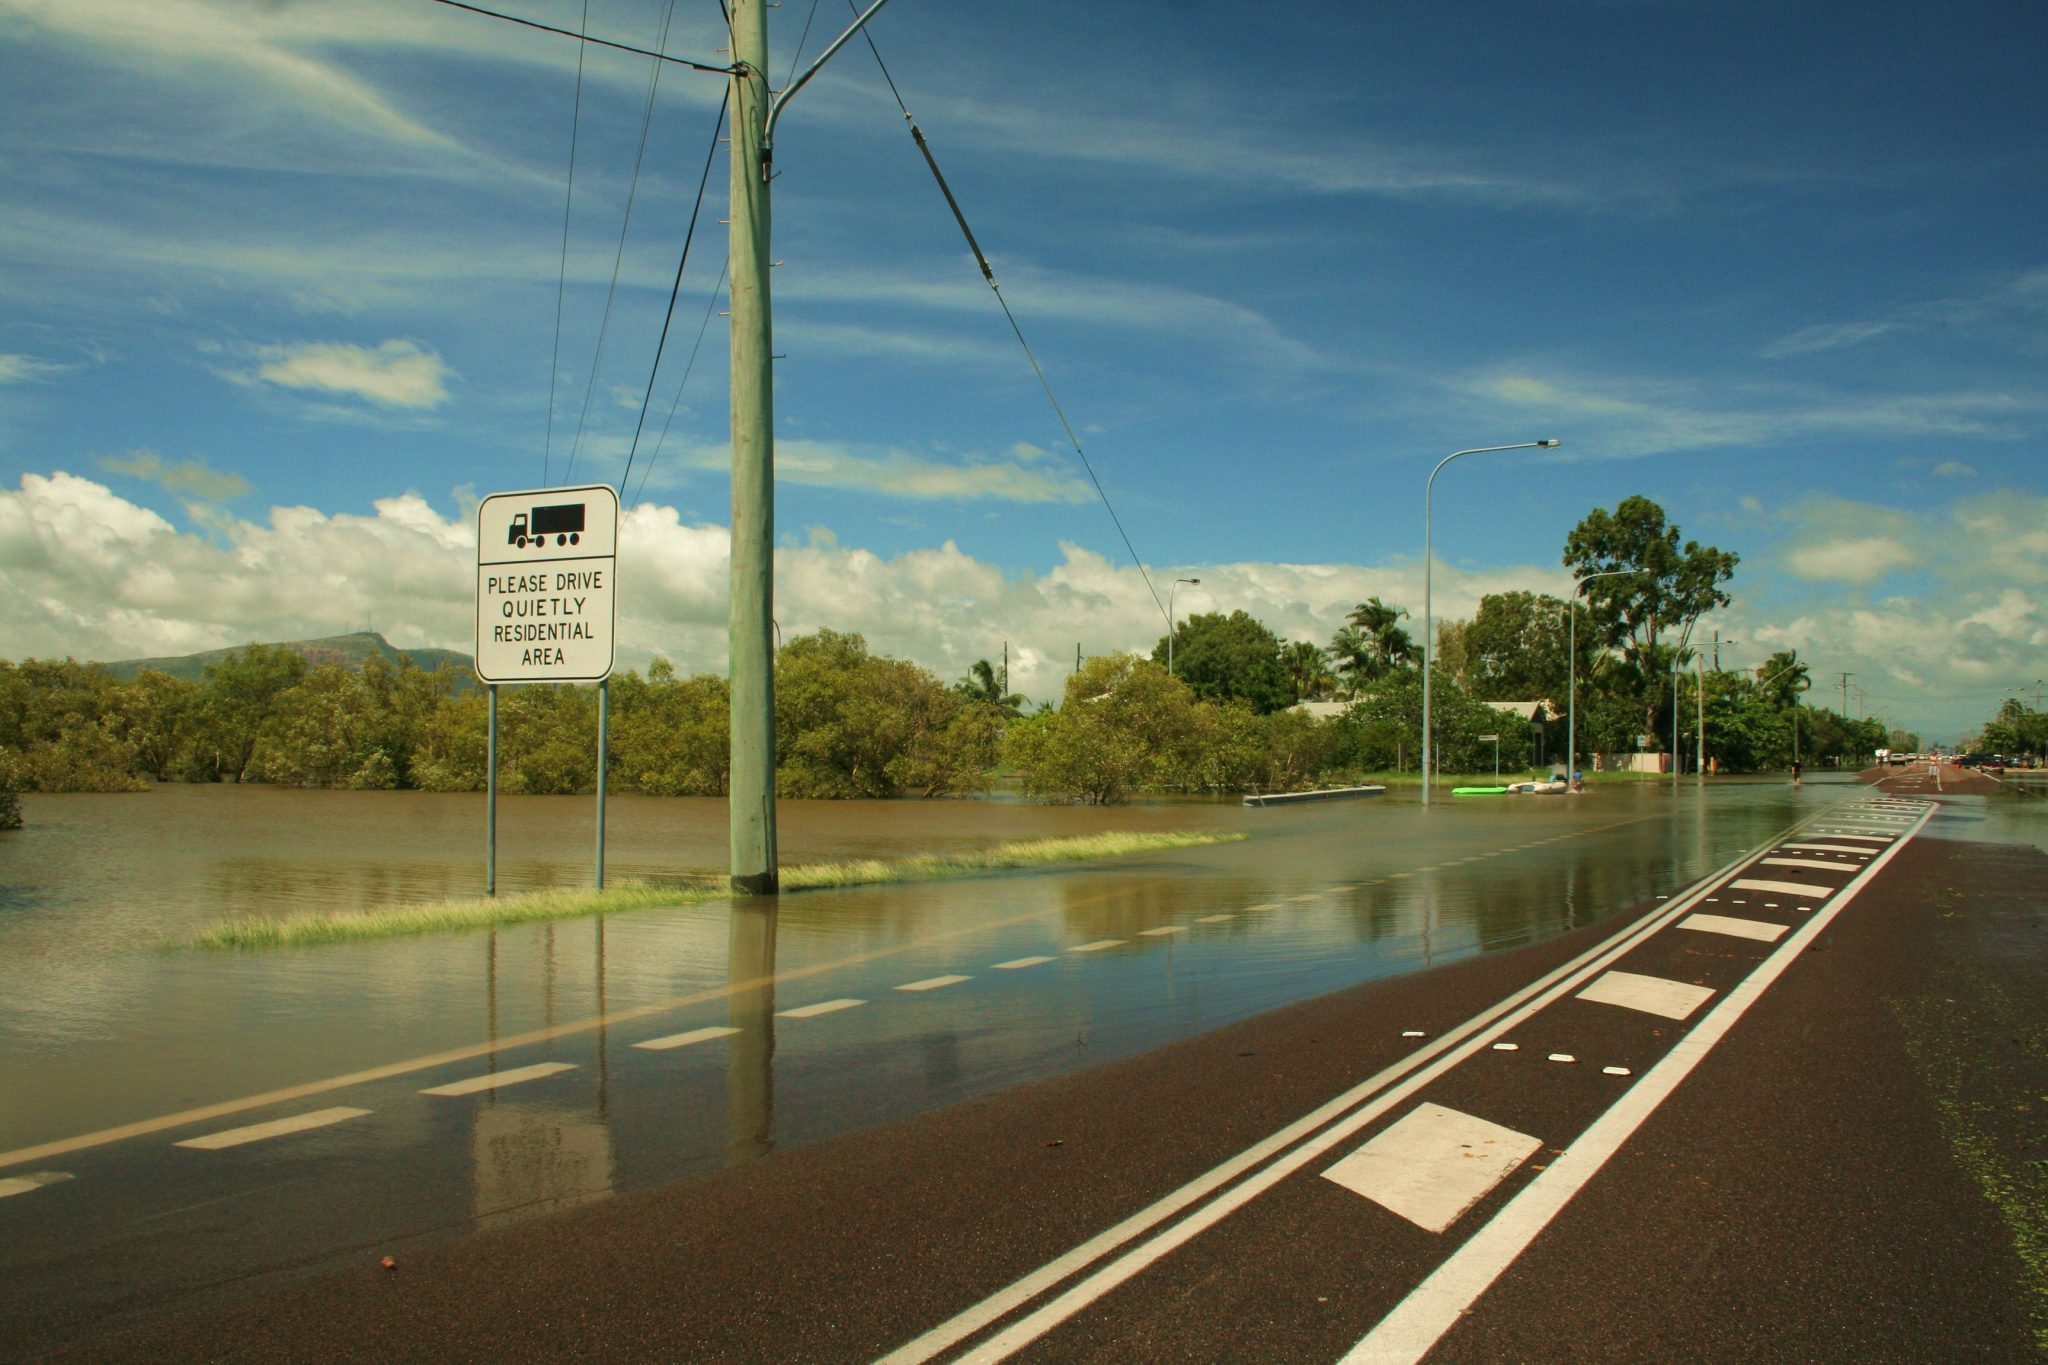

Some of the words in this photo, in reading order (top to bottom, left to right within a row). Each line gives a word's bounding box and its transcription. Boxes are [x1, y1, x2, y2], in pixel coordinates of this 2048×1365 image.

[488, 574, 548, 594] PLEASE
[556, 571, 603, 591] DRIVE
[502, 597, 587, 618] QUIETLY
[494, 622, 594, 642] RESIDENTIAL
[521, 647, 565, 666] AREA
